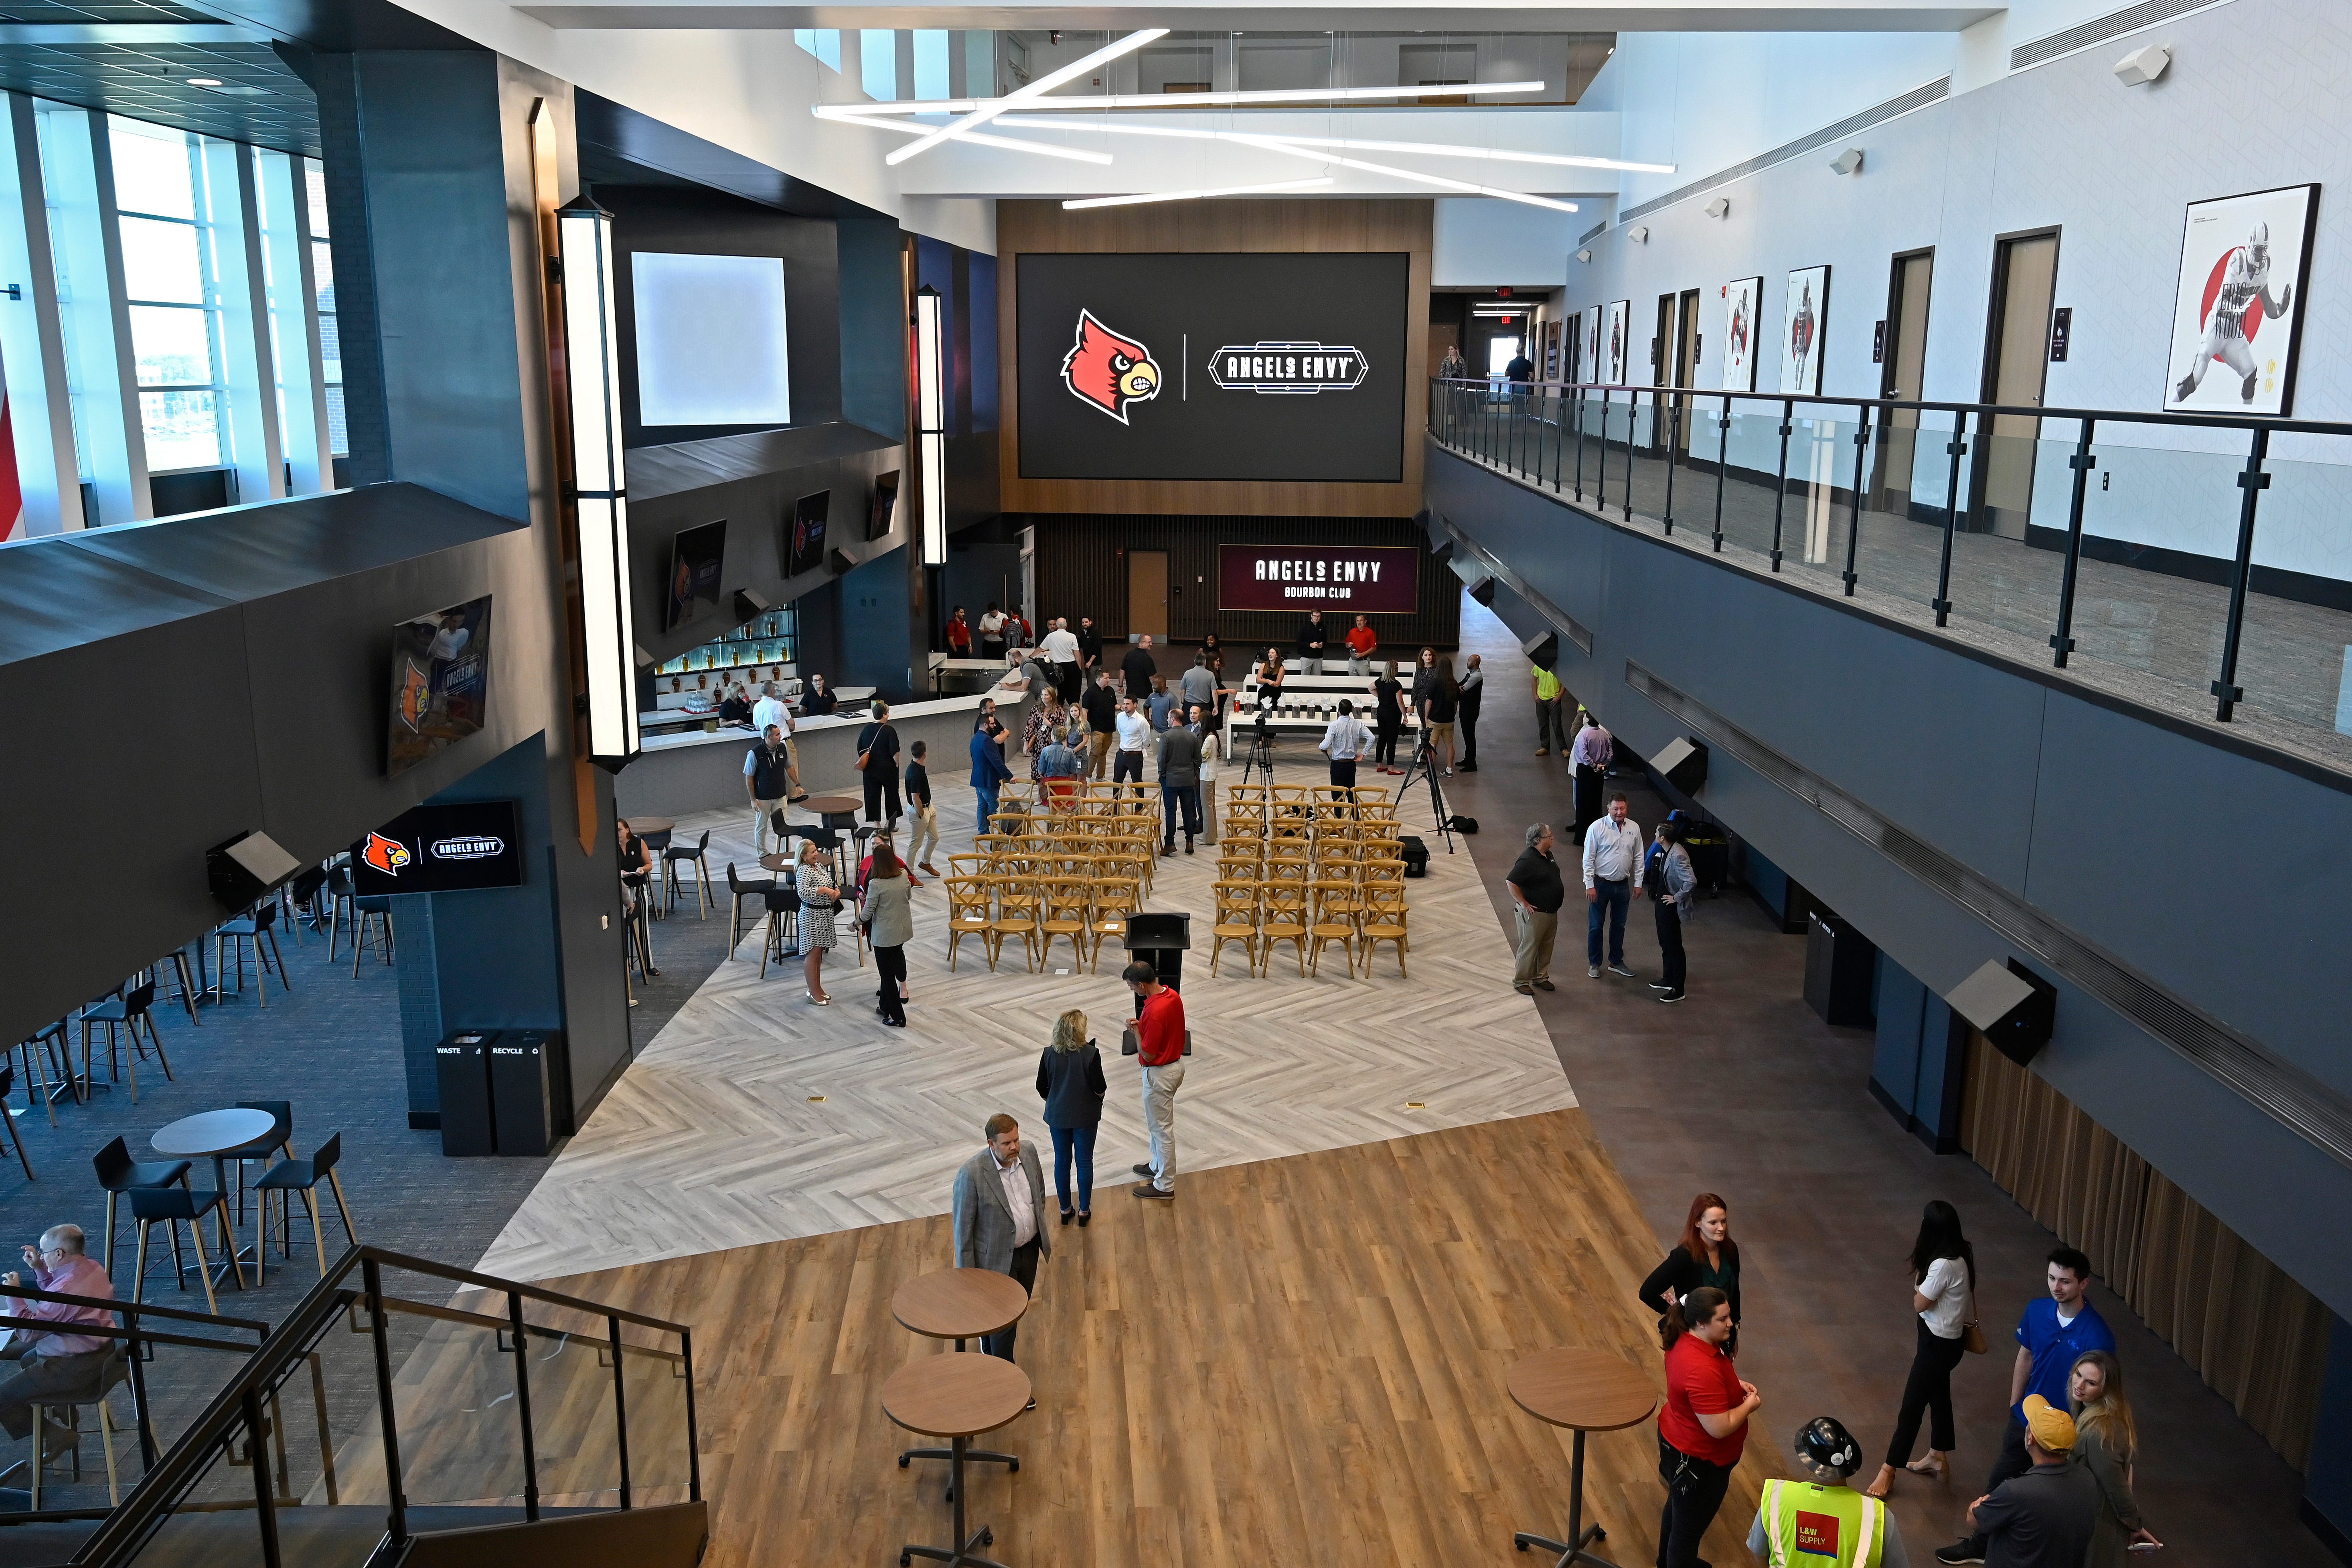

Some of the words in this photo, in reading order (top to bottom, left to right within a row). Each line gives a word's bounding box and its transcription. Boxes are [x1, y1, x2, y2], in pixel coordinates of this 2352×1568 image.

[1499, 288, 1511, 297] EXIT
[2220, 282, 2247, 310] ERIC
[2215, 311, 2247, 339] WOOD
[1227, 357, 1296, 379] ANGELS
[1255, 559, 1326, 582] ANGELS
[1333, 561, 1382, 582] ENVY
[1284, 586, 1326, 598] BOURBON
[1329, 587, 1351, 599] CLUB
[446, 667, 464, 688] ANGELS
[465, 661, 478, 679] ENVY
[439, 843, 472, 854] ANGELS
[1800, 1526, 1817, 1536] L&W
[1800, 1535, 1826, 1545] SUPPLY
